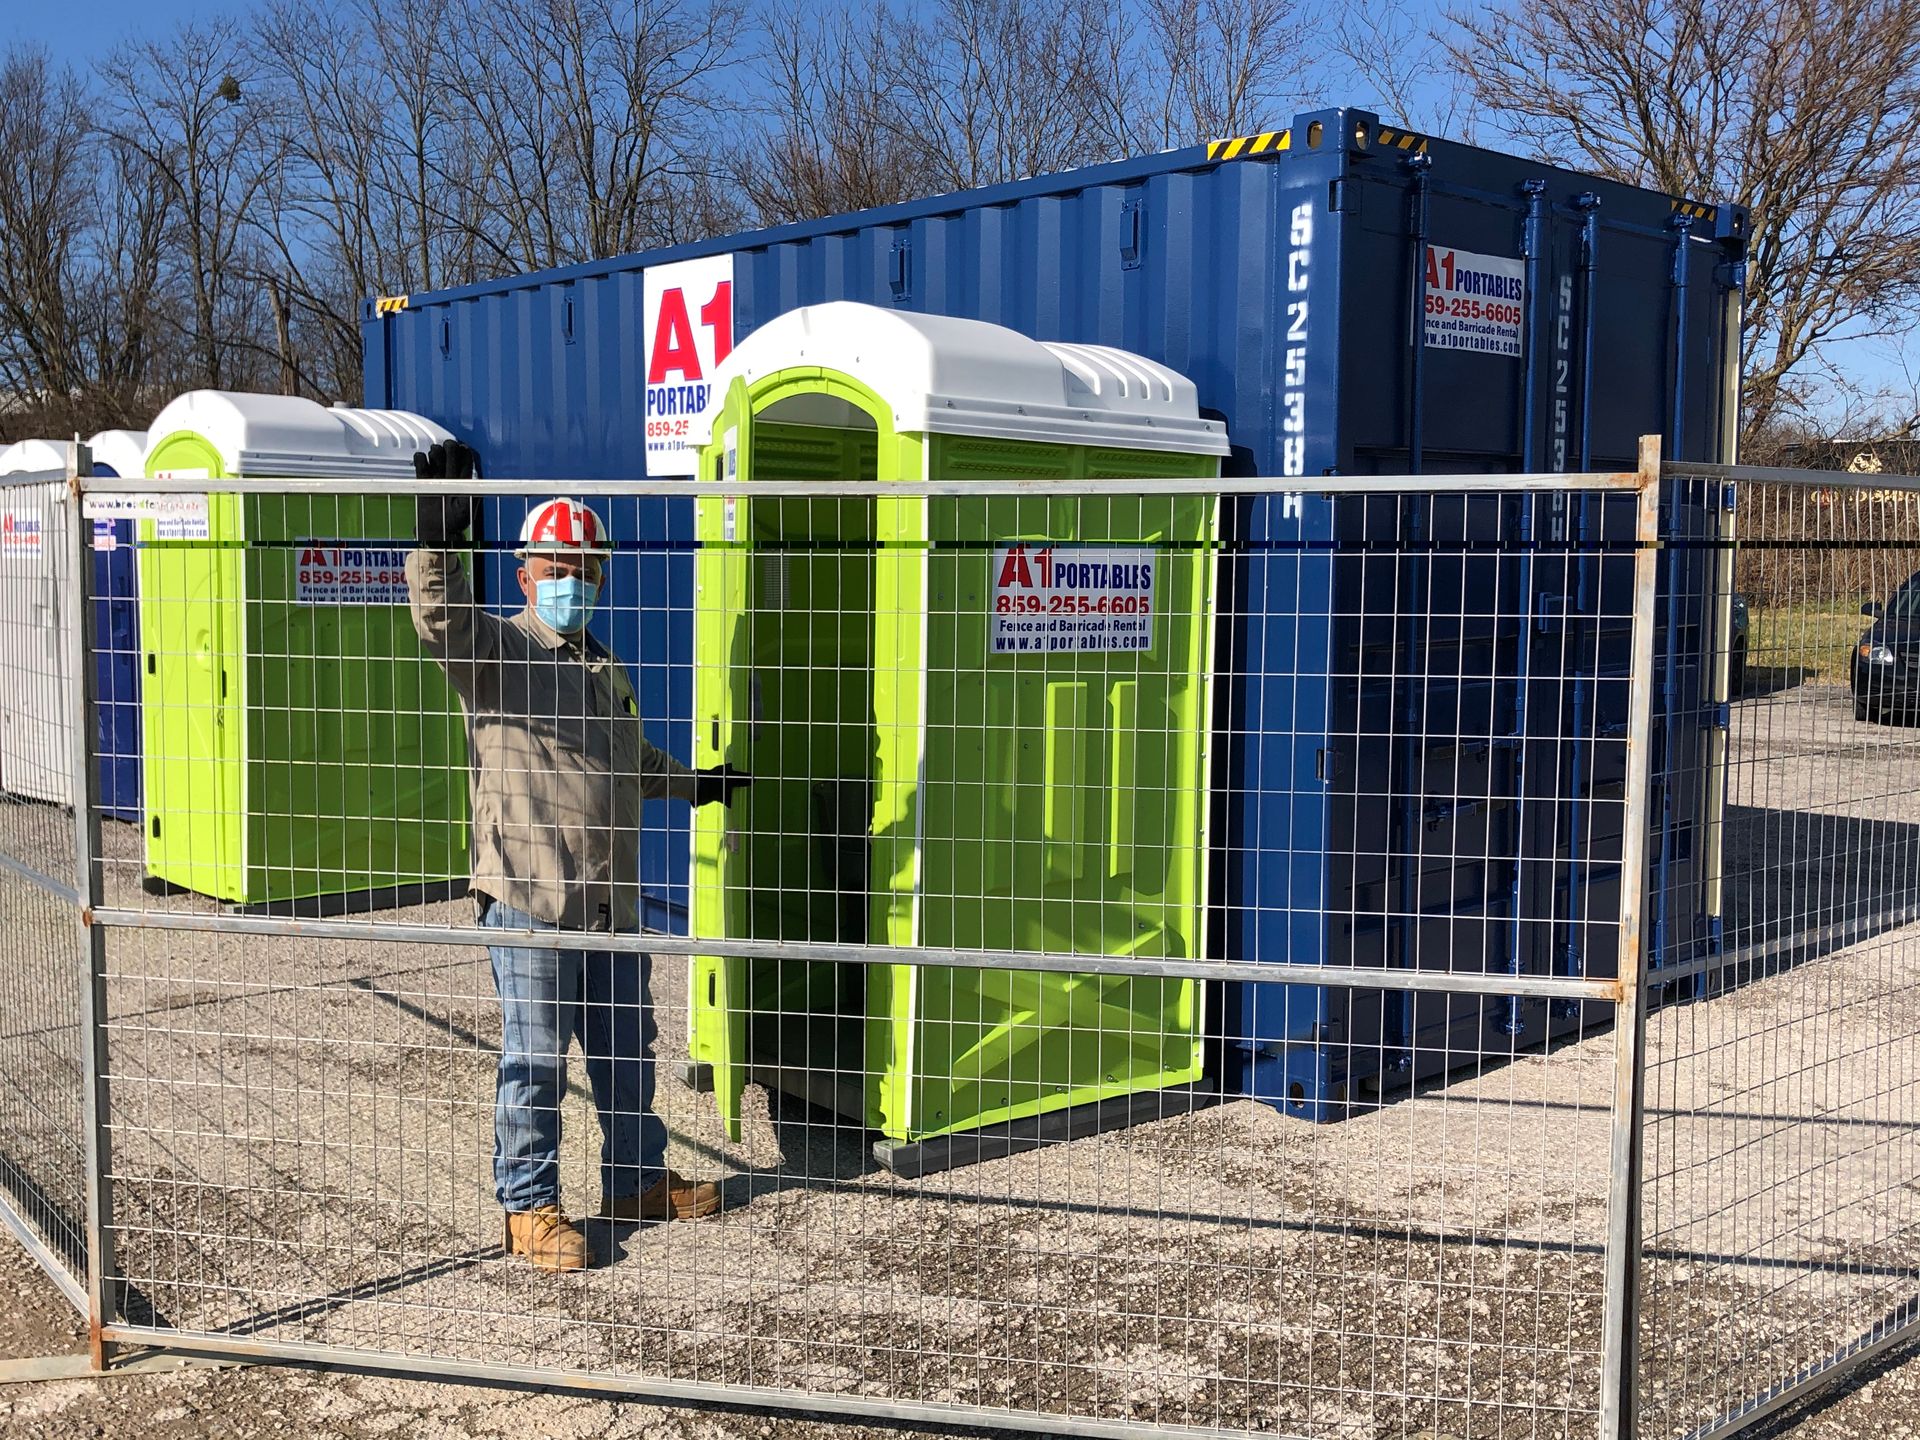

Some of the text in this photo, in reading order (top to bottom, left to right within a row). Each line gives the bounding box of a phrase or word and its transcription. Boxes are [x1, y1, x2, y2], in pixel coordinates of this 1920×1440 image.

[1426, 247, 1522, 301] A1 PORTABLES
[1425, 294, 1521, 325] 59-255-6605
[648, 280, 732, 384] A1
[1425, 319, 1518, 339] nce and Barricade Rental
[1425, 332, 1520, 354] ww.a1portables.com
[648, 384, 711, 416] PORTAB
[531, 502, 598, 548] A1
[344, 551, 408, 567] PORTABL
[998, 543, 1151, 590] A1 PORTABLES
[300, 571, 408, 584] 859-255-660
[996, 595, 1150, 616] 859-255-6605
[1000, 620, 1146, 633] Fence and Barricade Rental
